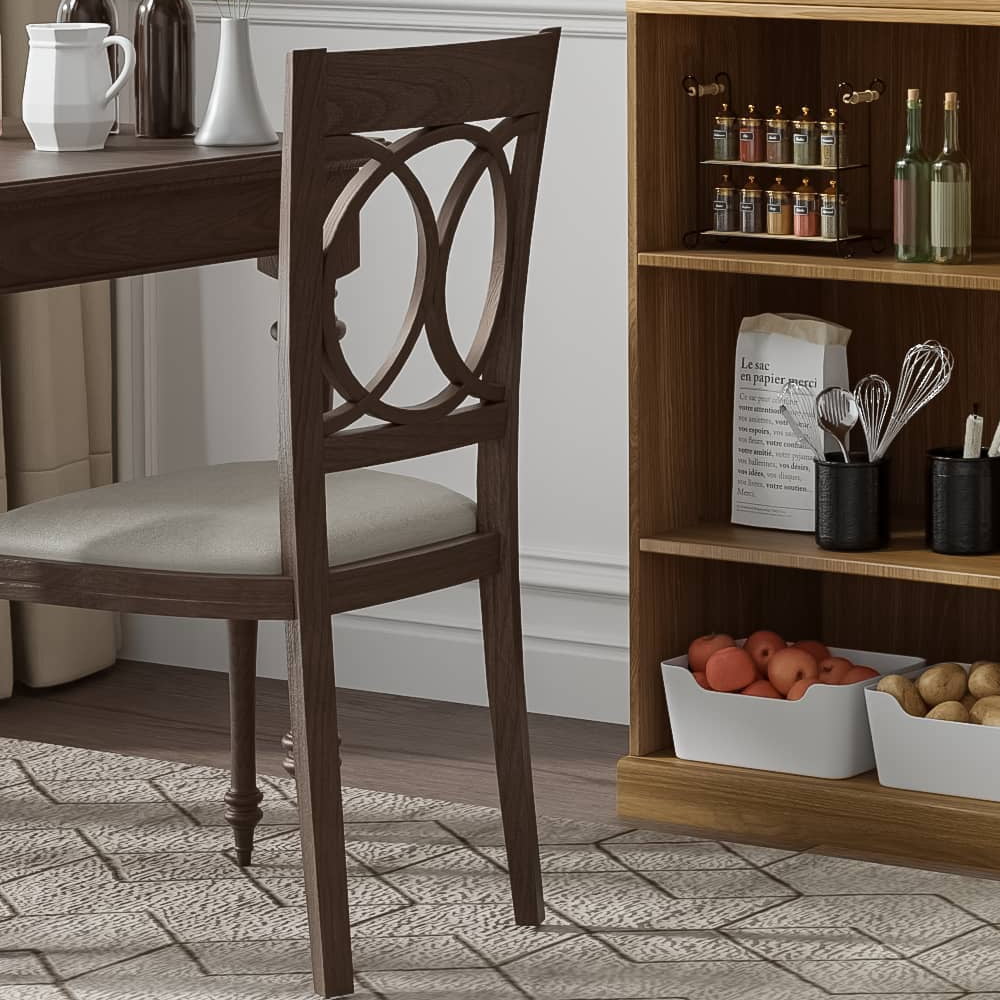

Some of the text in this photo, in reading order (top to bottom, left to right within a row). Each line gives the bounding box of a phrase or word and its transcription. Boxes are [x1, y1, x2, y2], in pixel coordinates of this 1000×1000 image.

[742, 357, 770, 371] Le sac
[740, 372, 817, 388] en papier merci
